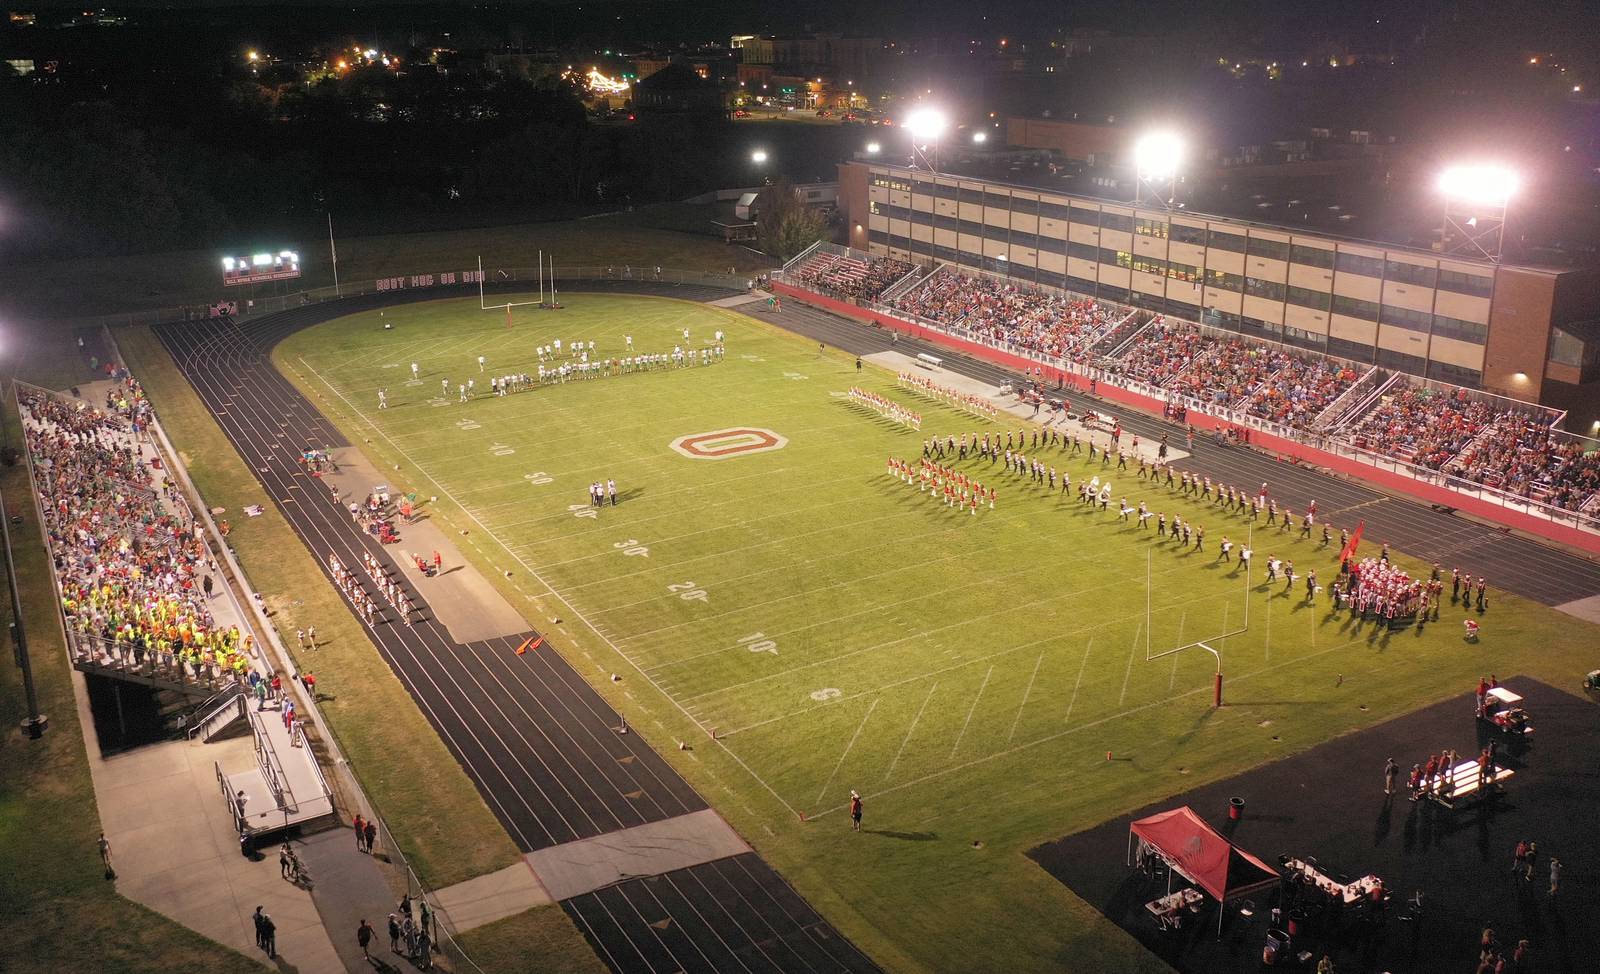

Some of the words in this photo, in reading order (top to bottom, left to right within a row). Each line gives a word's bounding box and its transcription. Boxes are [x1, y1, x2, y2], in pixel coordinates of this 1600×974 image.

[411, 275, 433, 287] HOG
[440, 273, 455, 284] OR
[524, 472, 554, 485] 50
[613, 539, 649, 556] 30
[667, 581, 708, 601] 20
[737, 631, 777, 653] 10
